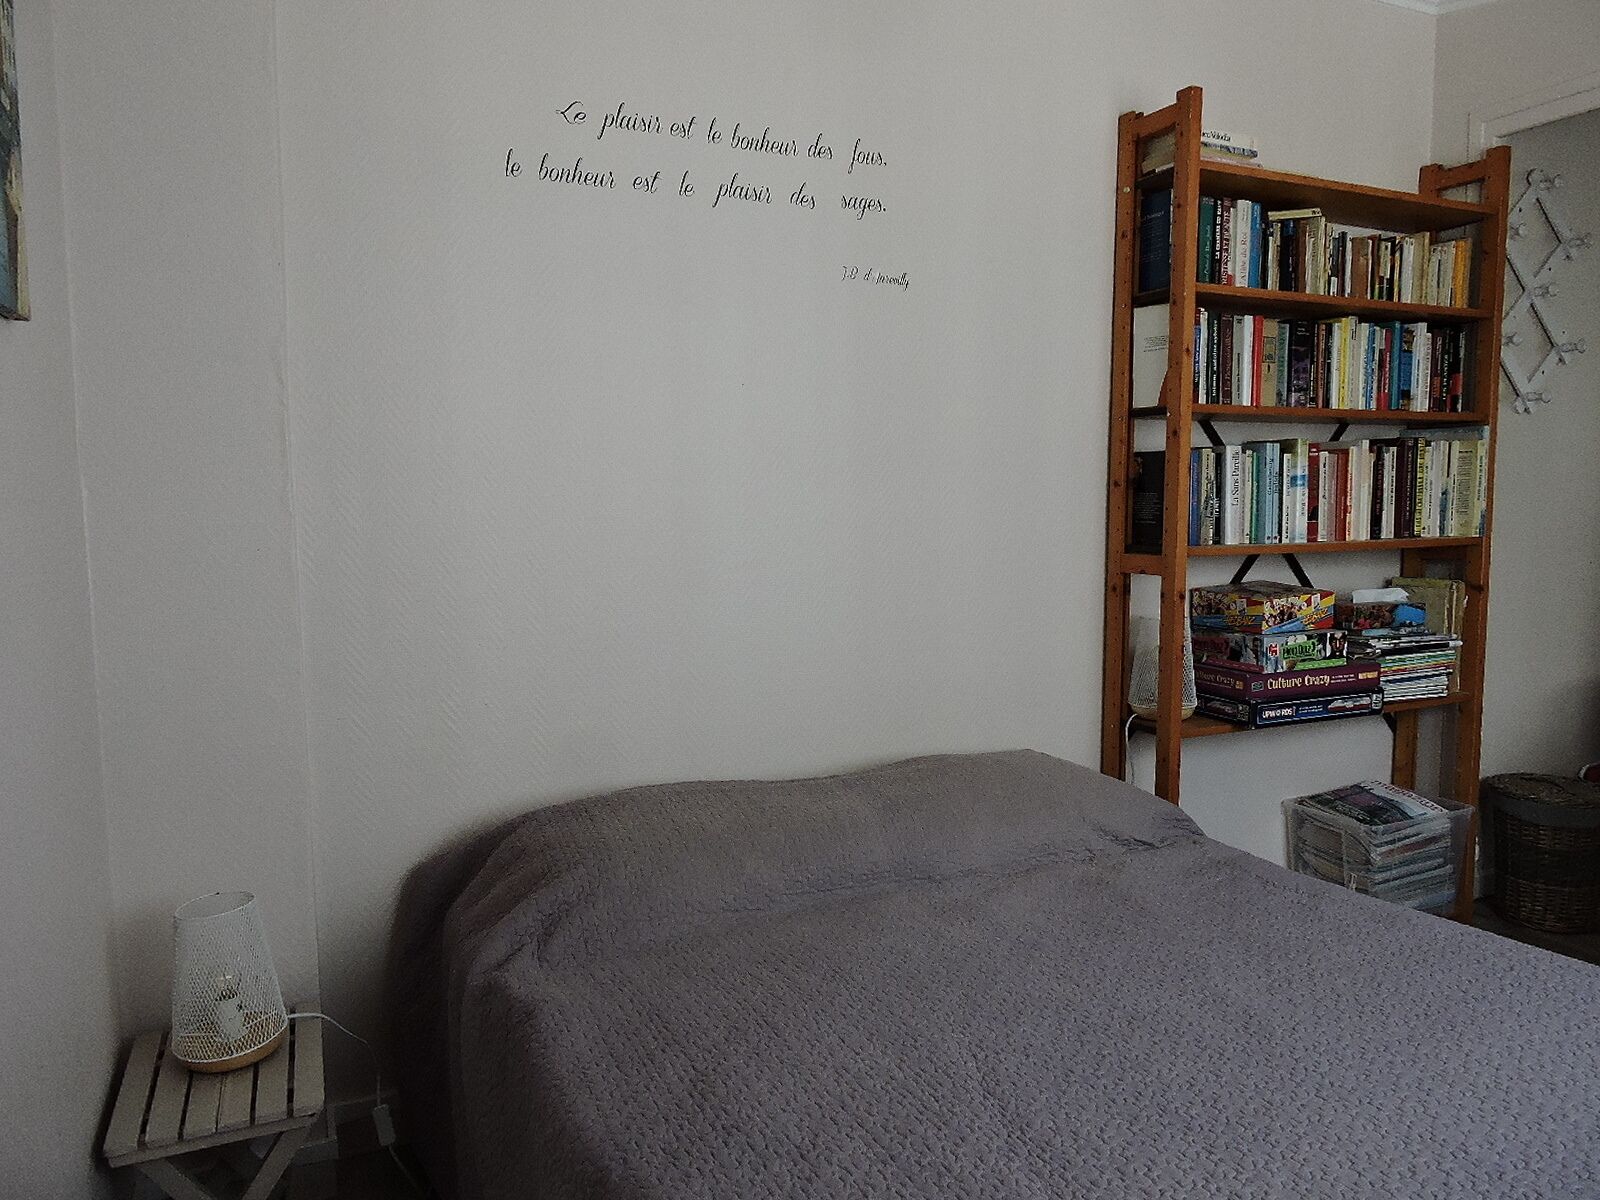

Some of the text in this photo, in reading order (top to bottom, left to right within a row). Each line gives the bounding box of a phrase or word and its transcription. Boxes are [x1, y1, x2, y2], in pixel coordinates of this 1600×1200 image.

[555, 100, 888, 175] Le plaisir est le bonheur des fous.
[505, 148, 887, 221] le bonheur est le plaisir des sages.
[1239, 231, 1248, 245] Roi
[1231, 449, 1241, 506] La Sans Pareille
[1267, 677, 1303, 690] Culture
[1304, 674, 1330, 688] Crazy
